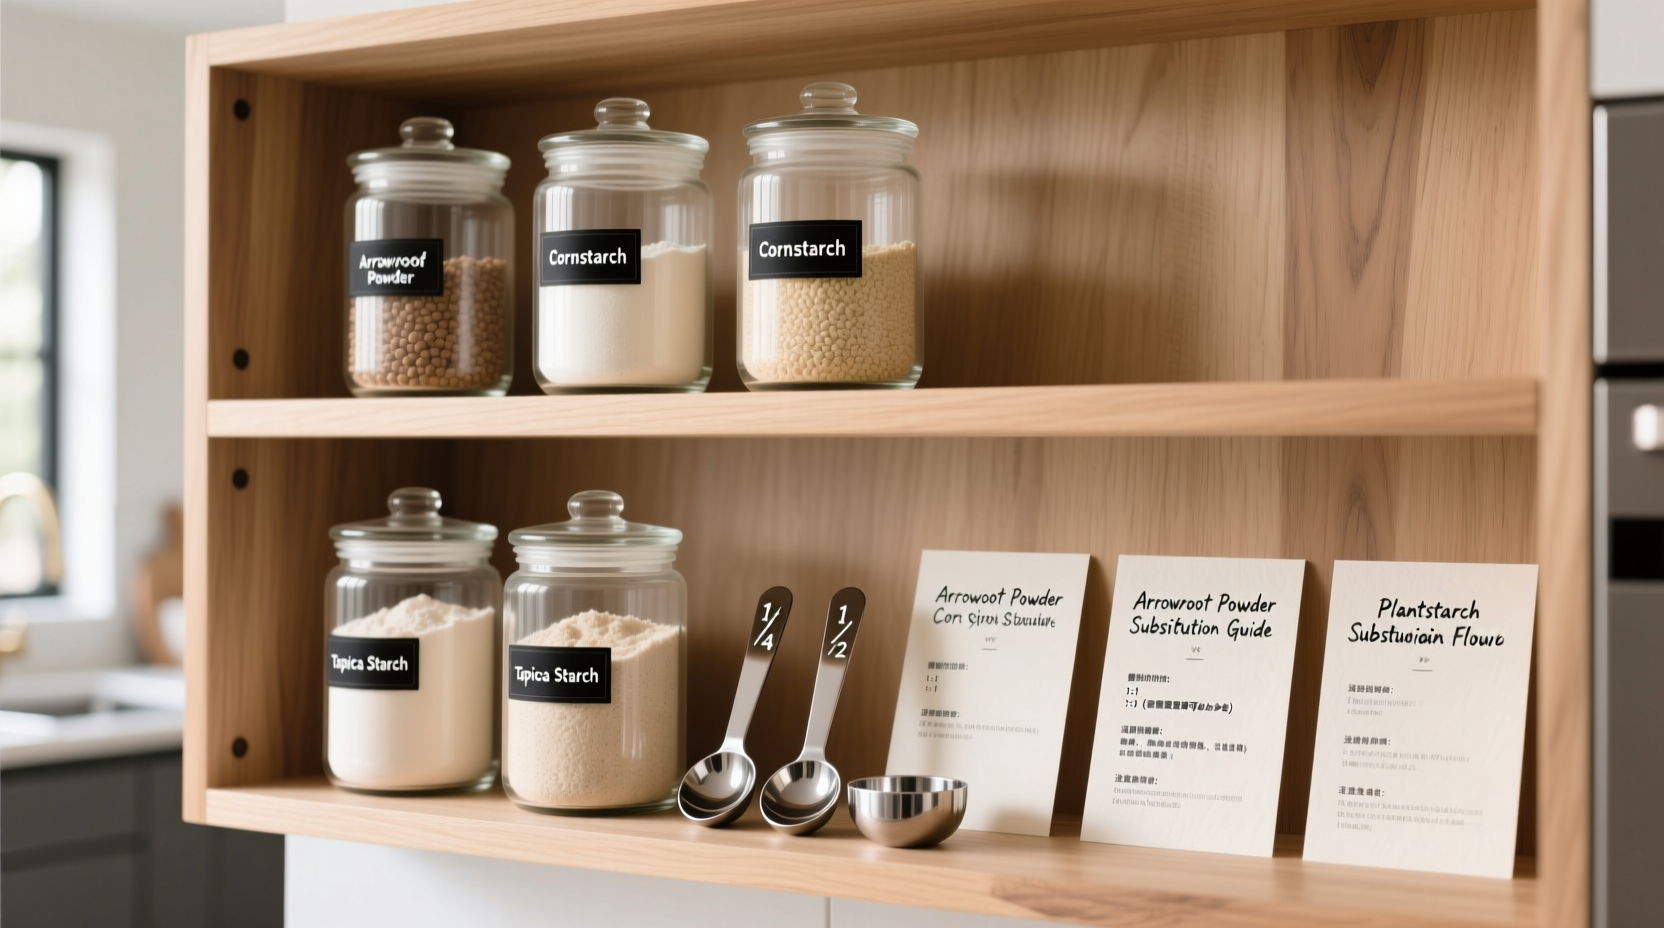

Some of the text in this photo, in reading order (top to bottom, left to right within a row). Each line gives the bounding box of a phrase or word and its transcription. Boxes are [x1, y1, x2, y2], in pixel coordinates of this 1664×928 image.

[548, 247, 627, 266] Cornstarch
[758, 238, 846, 258] Cornstarch
[367, 268, 415, 285] Powder
[1010, 587, 1064, 607] Powder
[1132, 590, 1277, 613] Arrowroot Powder
[1377, 597, 1480, 619] Plantstarch
[753, 602, 782, 651] 1/4
[1226, 618, 1273, 642] Guide
[366, 654, 408, 672] Starch
[554, 666, 599, 683] Starch
